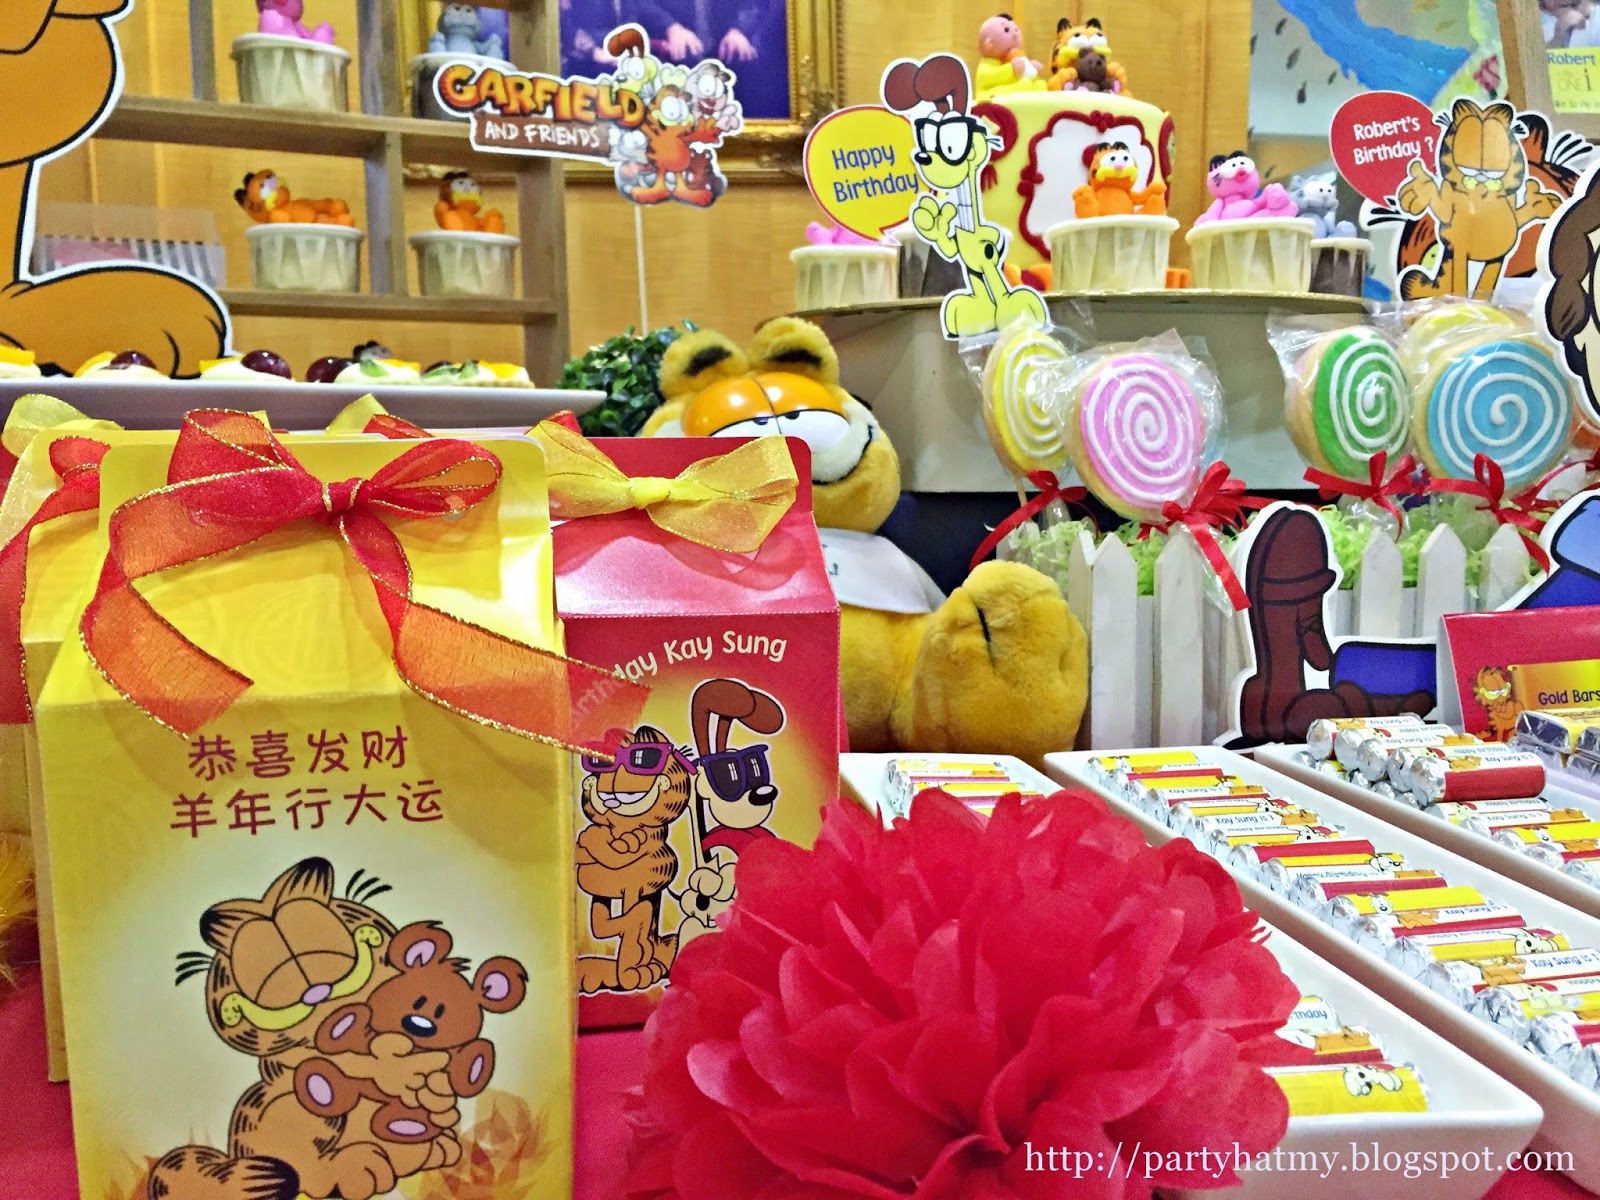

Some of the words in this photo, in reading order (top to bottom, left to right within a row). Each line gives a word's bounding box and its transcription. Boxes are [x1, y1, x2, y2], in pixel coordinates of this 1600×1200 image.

[438, 64, 645, 128] GARFIELD
[485, 121, 519, 140] AND
[524, 124, 600, 148] FRIENDS
[1353, 115, 1421, 141] Robert's
[832, 145, 895, 170] Happy
[1353, 141, 1421, 165] Birthday
[833, 172, 919, 202] Birthday
[663, 634, 713, 665] Kay
[722, 630, 787, 663] Sung
[1538, 690, 1569, 706] Gold
[1573, 689, 1600, 703] Bars
[188, 725, 408, 781] 恭喜发财
[170, 779, 444, 838] 羊年行大运
[1530, 959, 1552, 968] Kay
[1556, 956, 1582, 966] Sung
